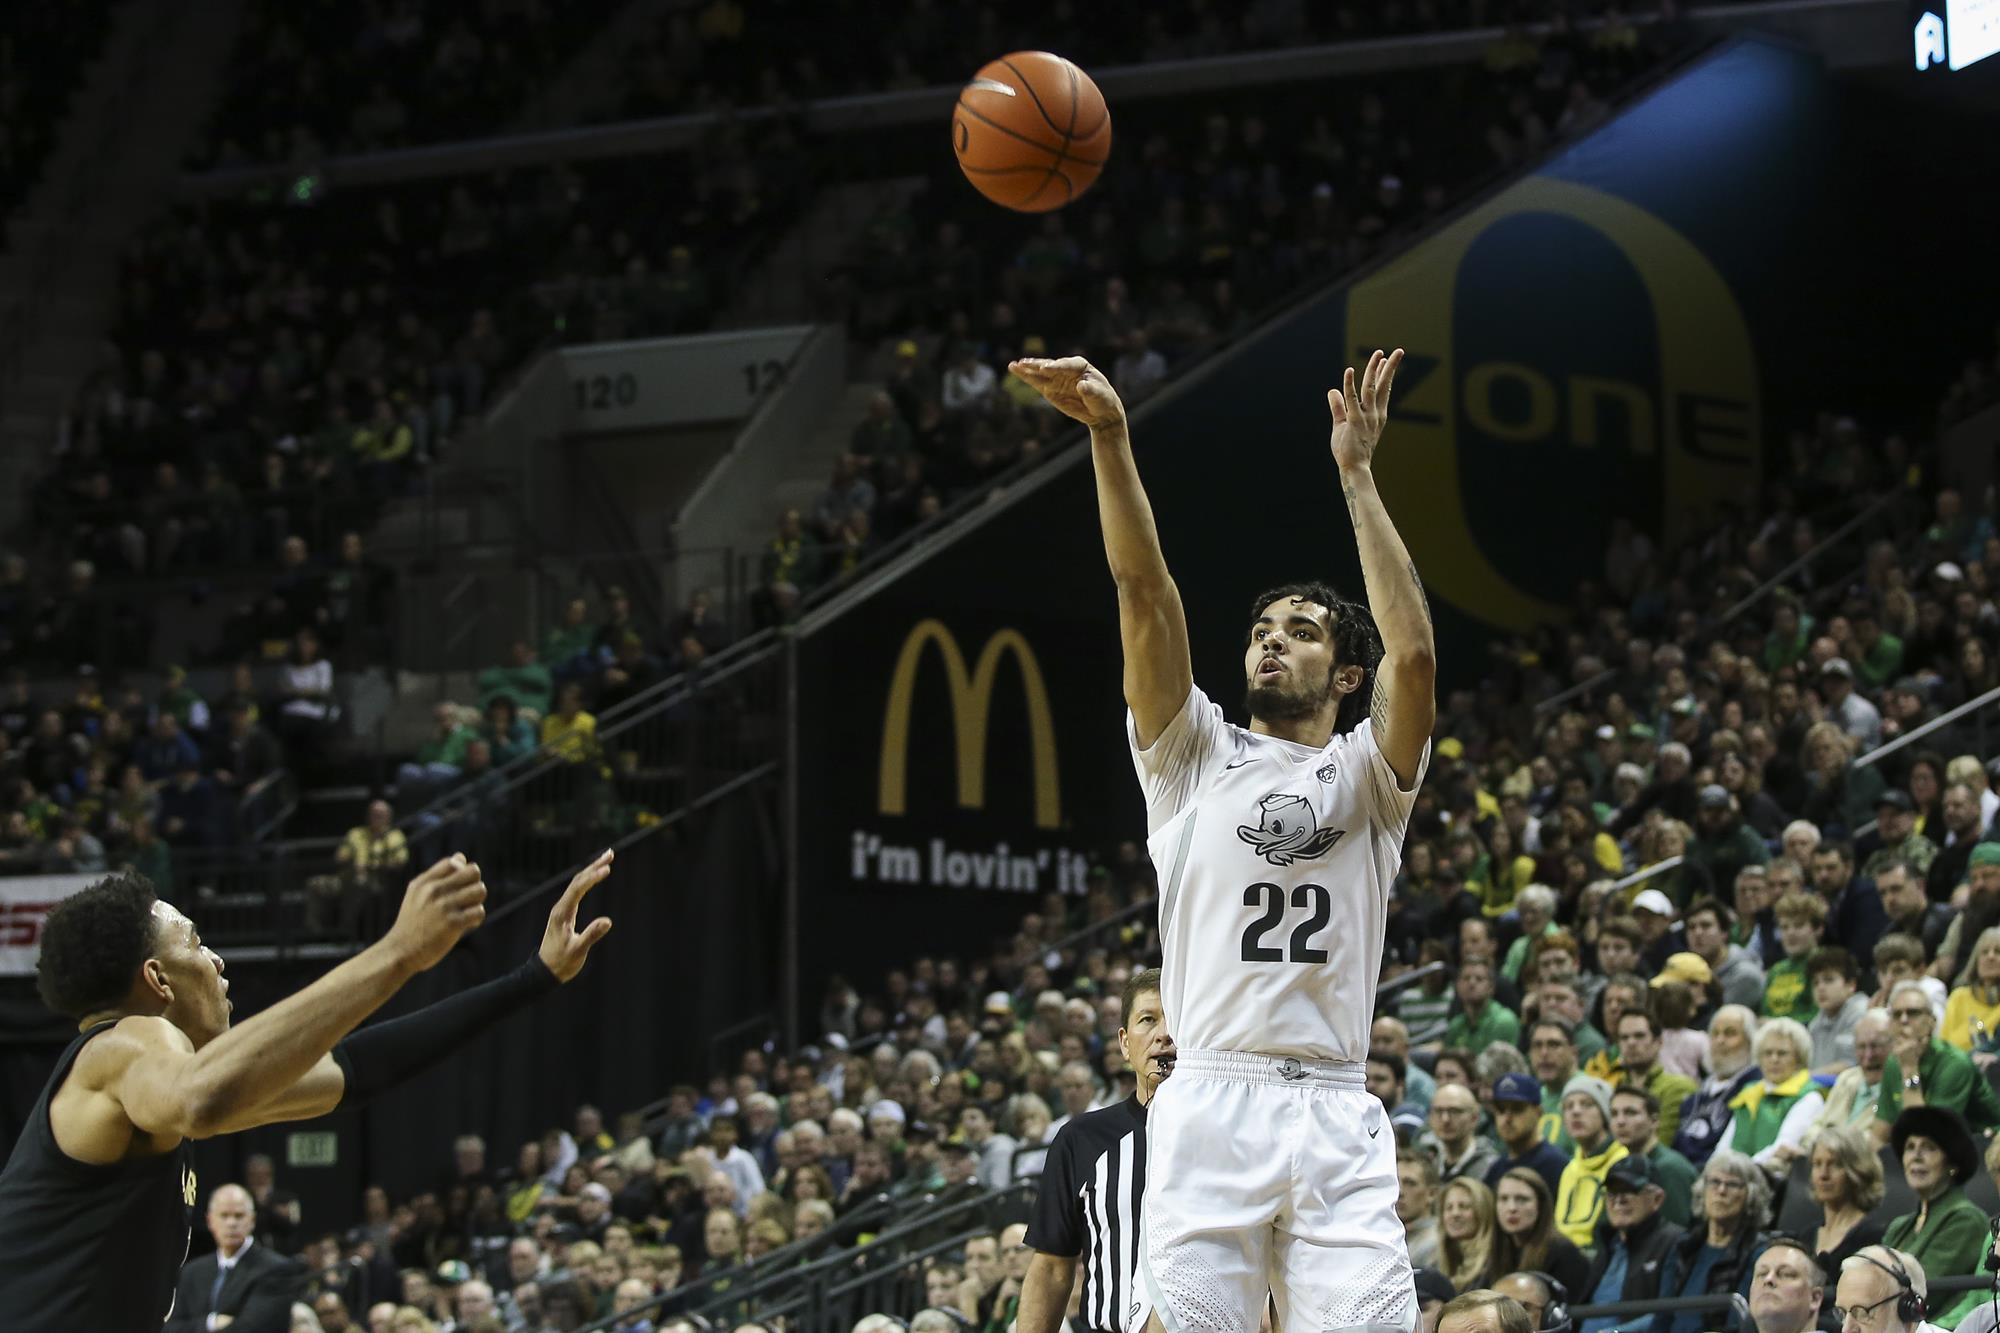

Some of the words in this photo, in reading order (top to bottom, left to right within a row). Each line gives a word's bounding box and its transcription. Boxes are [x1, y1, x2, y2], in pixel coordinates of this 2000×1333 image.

[573, 371, 637, 410] 120
[743, 360, 788, 396] 12
[851, 830, 922, 885] i'm
[929, 837, 1051, 893] lovin'
[1056, 847, 1089, 896] it
[1241, 882, 1331, 964] 22
